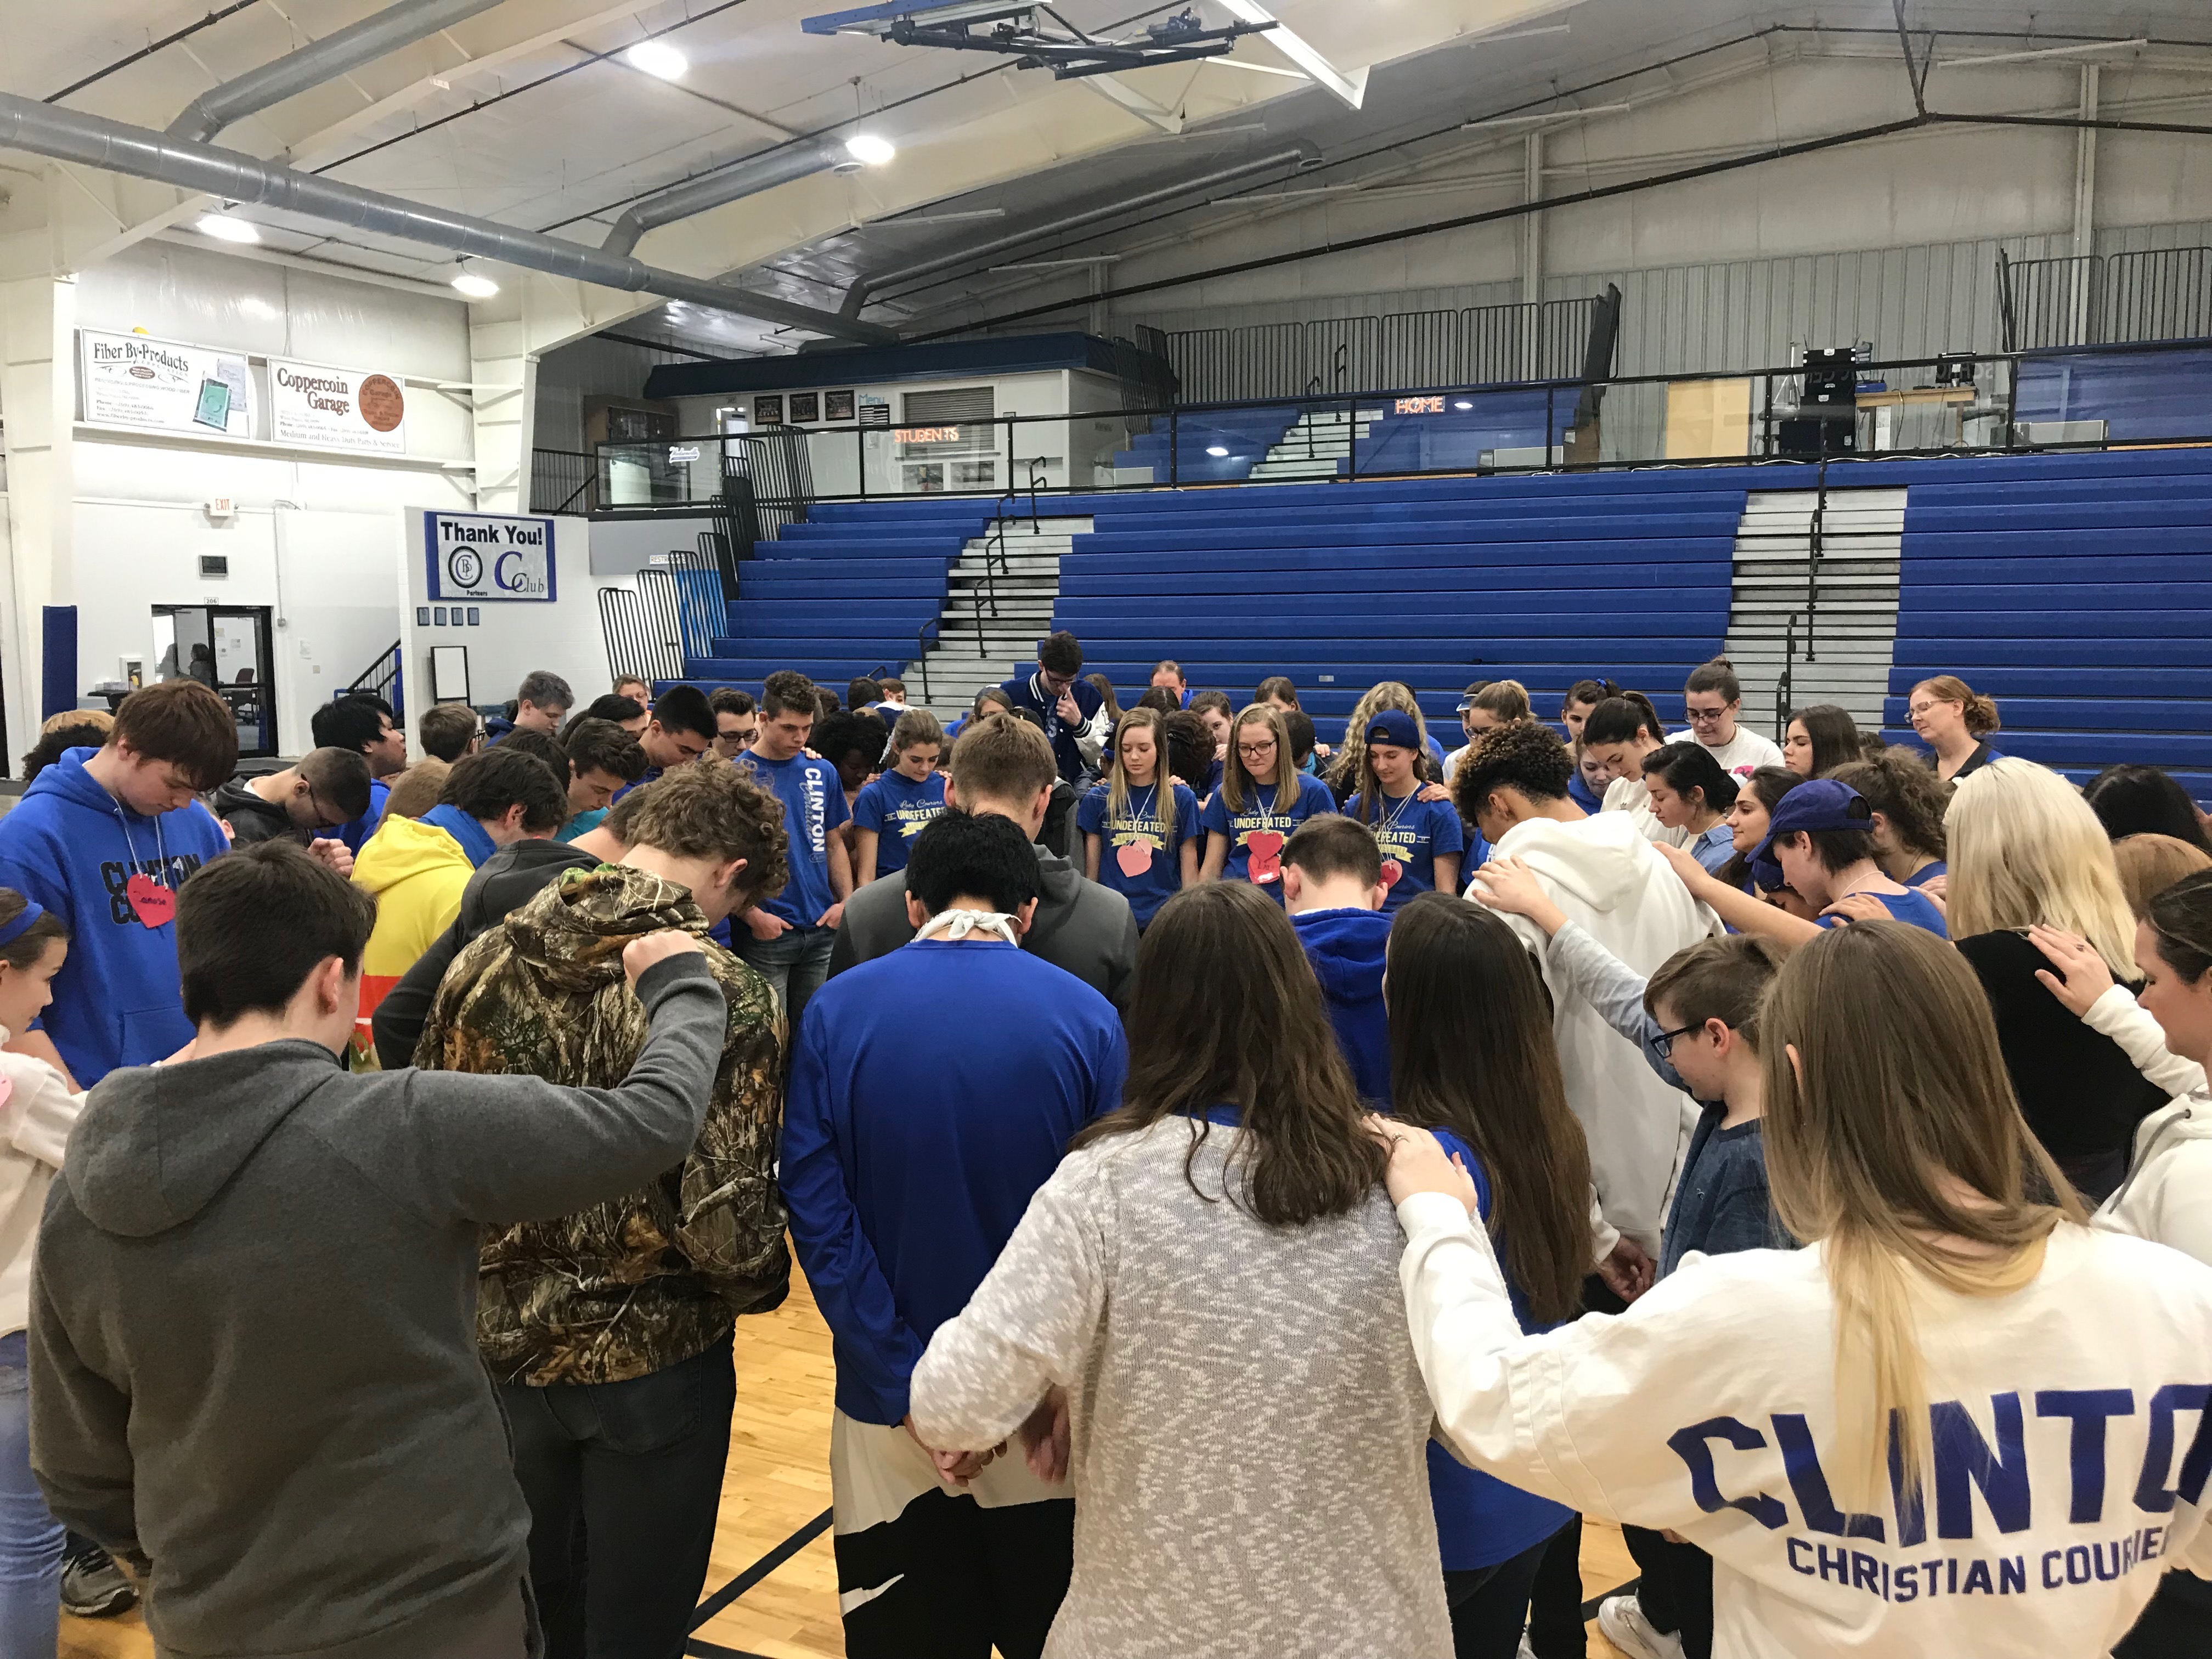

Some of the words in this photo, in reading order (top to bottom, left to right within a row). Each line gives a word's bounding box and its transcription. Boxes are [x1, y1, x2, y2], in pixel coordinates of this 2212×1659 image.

[94, 343, 122, 359] Fiber
[125, 342, 189, 371] By-Products
[277, 368, 348, 394] Coppercoin
[307, 391, 349, 416] Garage
[859, 393, 884, 405] Menu
[1396, 396, 1443, 414] HOME
[280, 430, 307, 439] Medium
[309, 432, 320, 440] and
[895, 427, 959, 443] STUDENTS
[216, 499, 230, 511] EXIT
[440, 521, 500, 543] Thank
[504, 525, 543, 545] You!
[805, 768, 825, 852] CLINTON
[1786, 1537, 2027, 1604] CHRISTIAN
